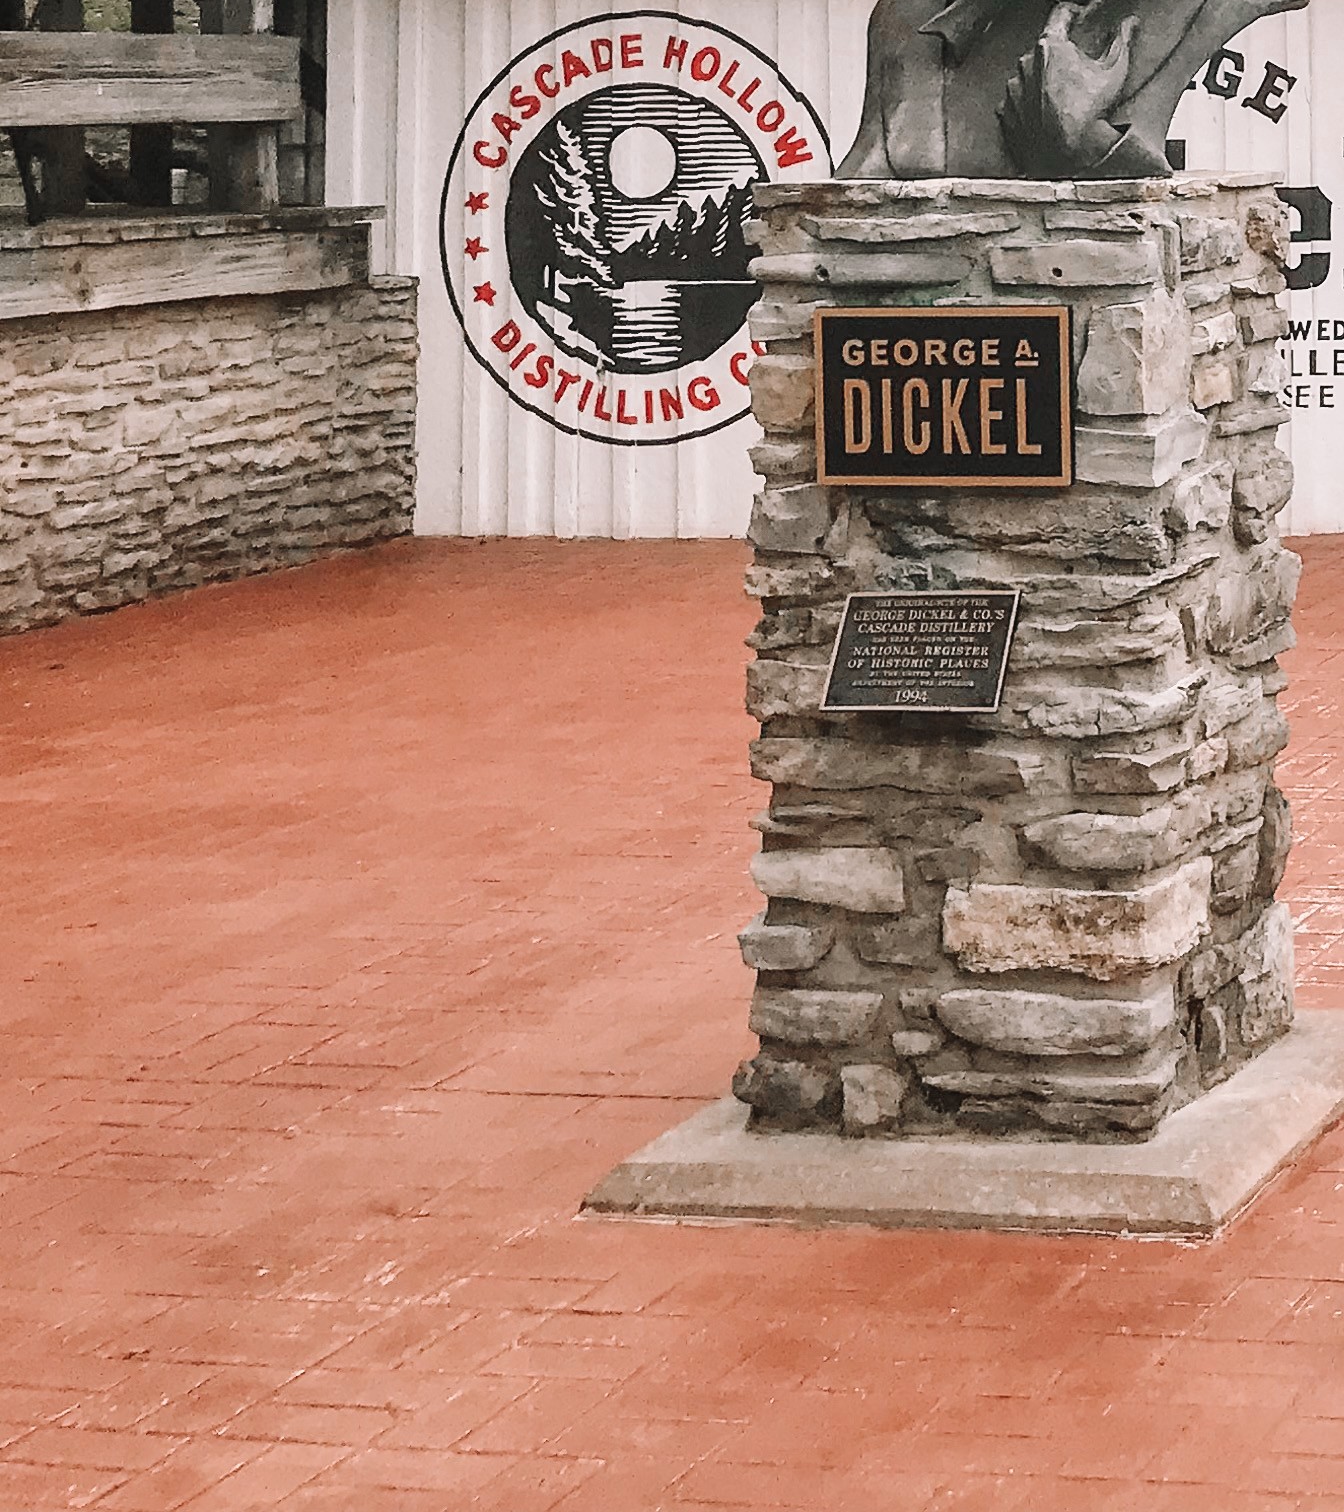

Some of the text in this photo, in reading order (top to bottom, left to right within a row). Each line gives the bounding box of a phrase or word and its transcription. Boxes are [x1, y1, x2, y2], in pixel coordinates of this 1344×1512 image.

[472, 34, 814, 170] CASCADE HOLLOW
[842, 338, 1040, 367] GEORGE A.
[490, 318, 767, 425] DISTILLING C
[844, 377, 1042, 455] DICKEL
[853, 610, 906, 622] GEORGE
[908, 609, 957, 621] DICKEL
[959, 609, 970, 620] &
[857, 622, 995, 635] CASCADE DISTILLERY
[852, 645, 990, 657] NATIONAL REGISTER
[847, 659, 865, 670] OF
[870, 659, 934, 670] HISTORIC
[894, 688, 929, 703] 1994
